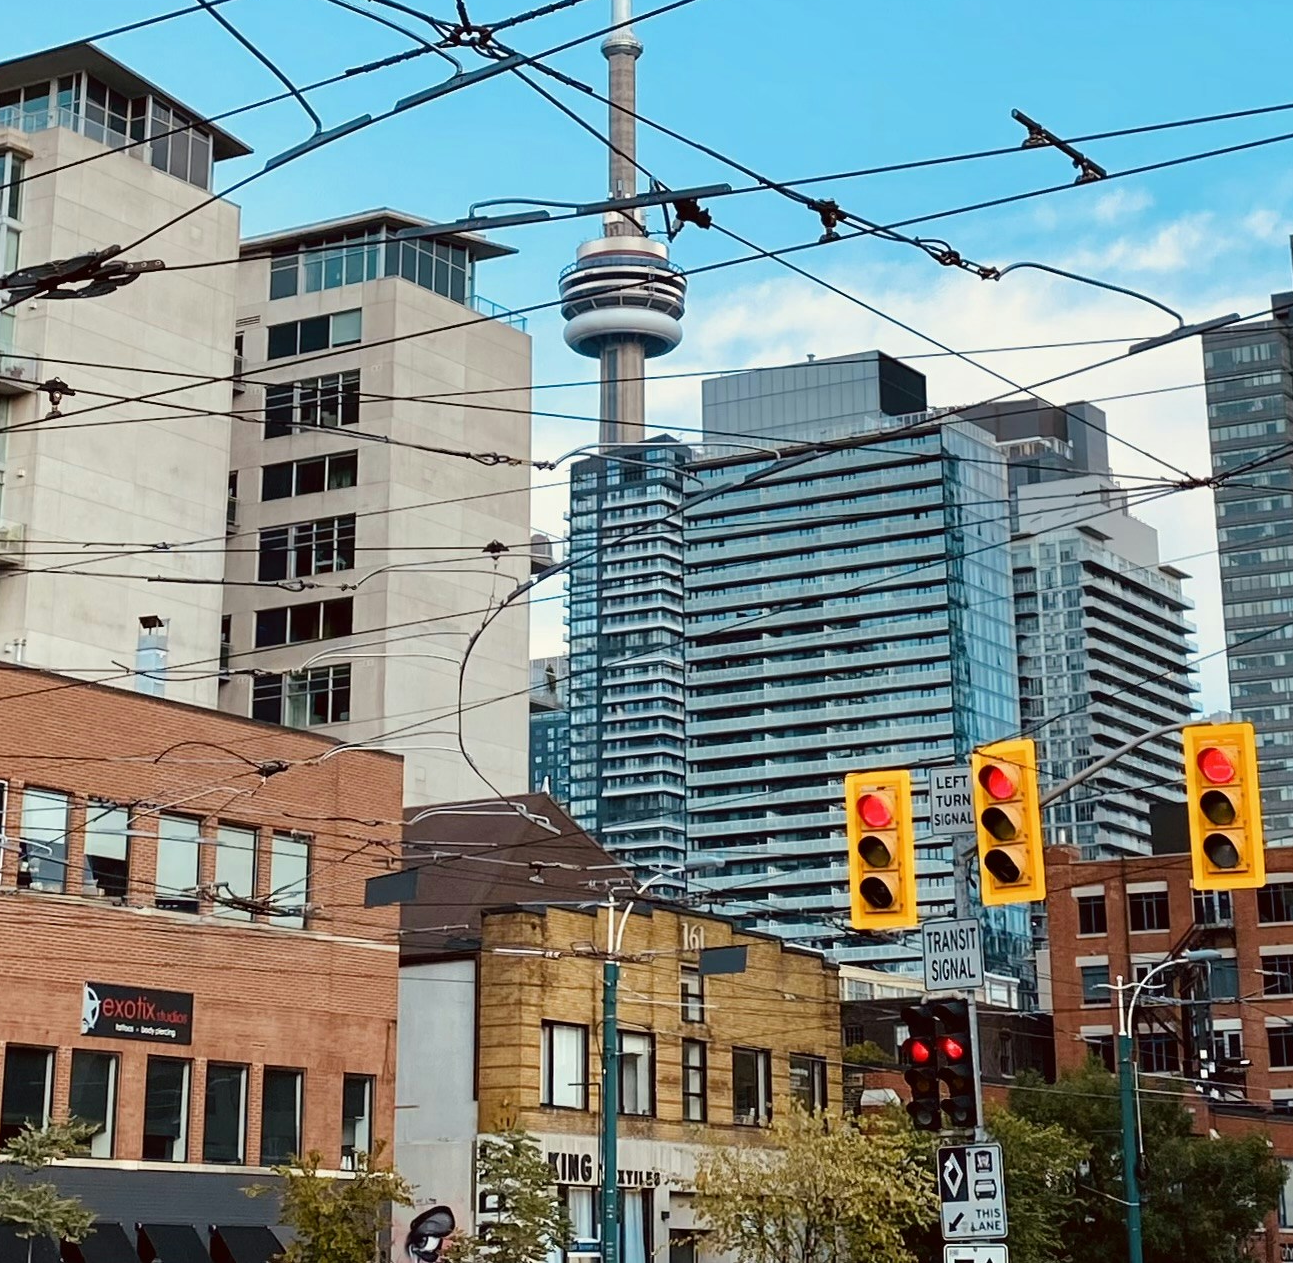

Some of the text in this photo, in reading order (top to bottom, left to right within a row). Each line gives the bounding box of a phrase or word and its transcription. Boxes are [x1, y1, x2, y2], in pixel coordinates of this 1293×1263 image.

[936, 775, 968, 790] LEFT
[936, 794, 971, 808] TURN
[934, 812, 974, 827] SIGNAL
[681, 923, 705, 951] 161
[926, 927, 976, 954] TRANSIT
[932, 956, 976, 982] SIGNAL
[102, 996, 188, 1025] exotix studios
[548, 1152, 592, 1183] KING
[616, 1169, 661, 1187] XTILES
[975, 1208, 1001, 1219] THIS
[971, 1220, 1002, 1233] LANE
